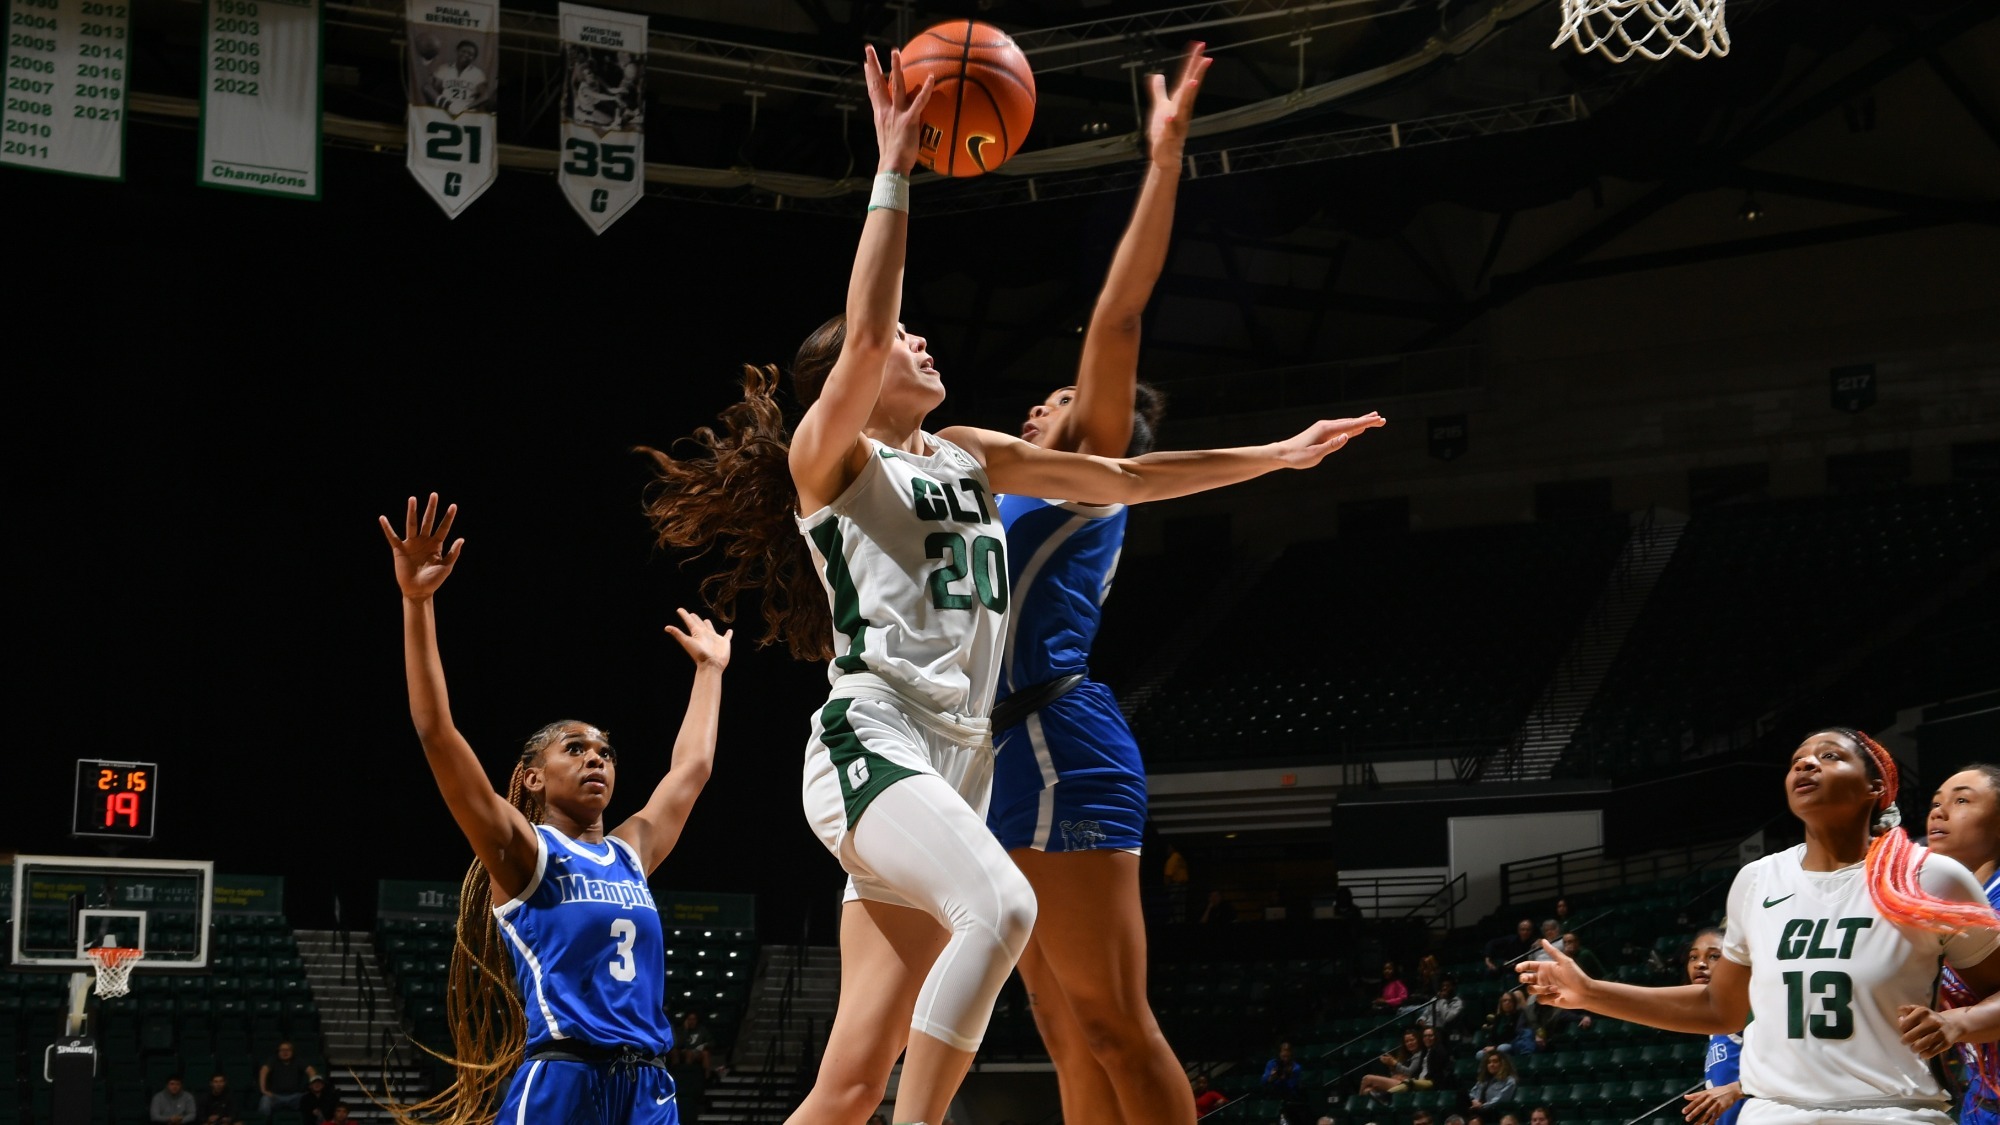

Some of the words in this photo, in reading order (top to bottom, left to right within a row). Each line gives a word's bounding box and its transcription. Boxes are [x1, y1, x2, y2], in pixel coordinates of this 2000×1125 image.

[81, 1, 126, 19] 2012
[217, 0, 258, 17] 1990
[435, 6, 471, 17] PAULA
[12, 12, 57, 31] 2004
[215, 17, 260, 36] 2003
[425, 13, 480, 28] BENNETT
[80, 22, 124, 39] 2013
[580, 33, 624, 47] WILSON
[11, 33, 56, 52] 2005
[79, 44, 123, 60] 2014
[214, 38, 260, 56] 2006
[9, 55, 55, 74] 2006
[77, 63, 122, 81] 2016
[214, 56, 260, 75] 2009
[8, 76, 54, 95] 2007
[75, 84, 120, 100] 2019
[214, 78, 259, 96] 2022
[7, 97, 53, 116] 2008
[74, 105, 120, 121] 2021
[6, 119, 51, 138] 2010
[4, 140, 49, 159] 2011
[426, 121, 482, 164] 21
[564, 137, 635, 182] 35
[212, 165, 307, 187] Champions
[1837, 374, 1871, 392] 217
[911, 476, 992, 526] CLT
[924, 532, 1008, 615] 20
[97, 769, 147, 792] 2:15
[105, 792, 139, 828] 19
[1776, 917, 1874, 961] CLT
[609, 918, 637, 982] 3
[1782, 970, 1854, 1040] 13
[57, 1045, 94, 1055] SPALDING
